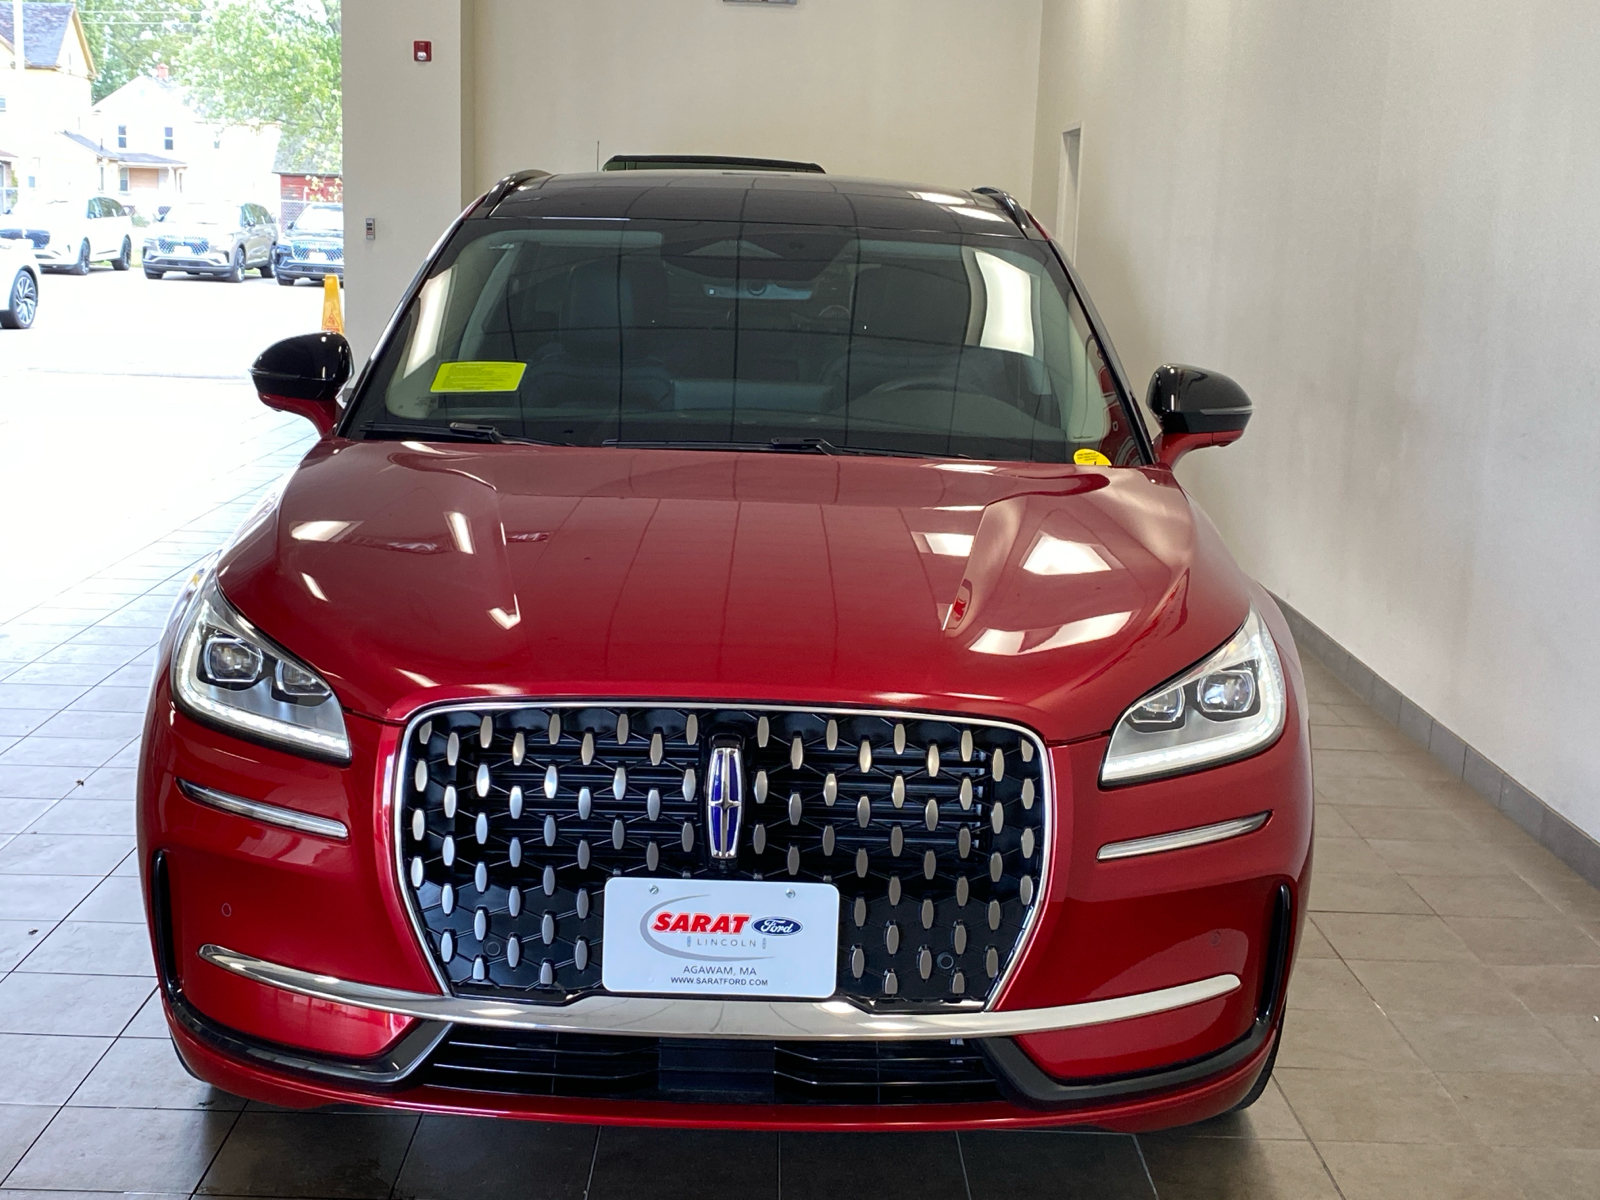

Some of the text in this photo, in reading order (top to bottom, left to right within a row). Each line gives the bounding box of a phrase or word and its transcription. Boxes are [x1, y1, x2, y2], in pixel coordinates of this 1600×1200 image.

[652, 912, 794, 934] SARAT Ford
[697, 938, 757, 947] LINCOLN
[682, 965, 757, 976] AGAWAM, MA
[670, 976, 768, 986] WWW.SARATFORD.COM
